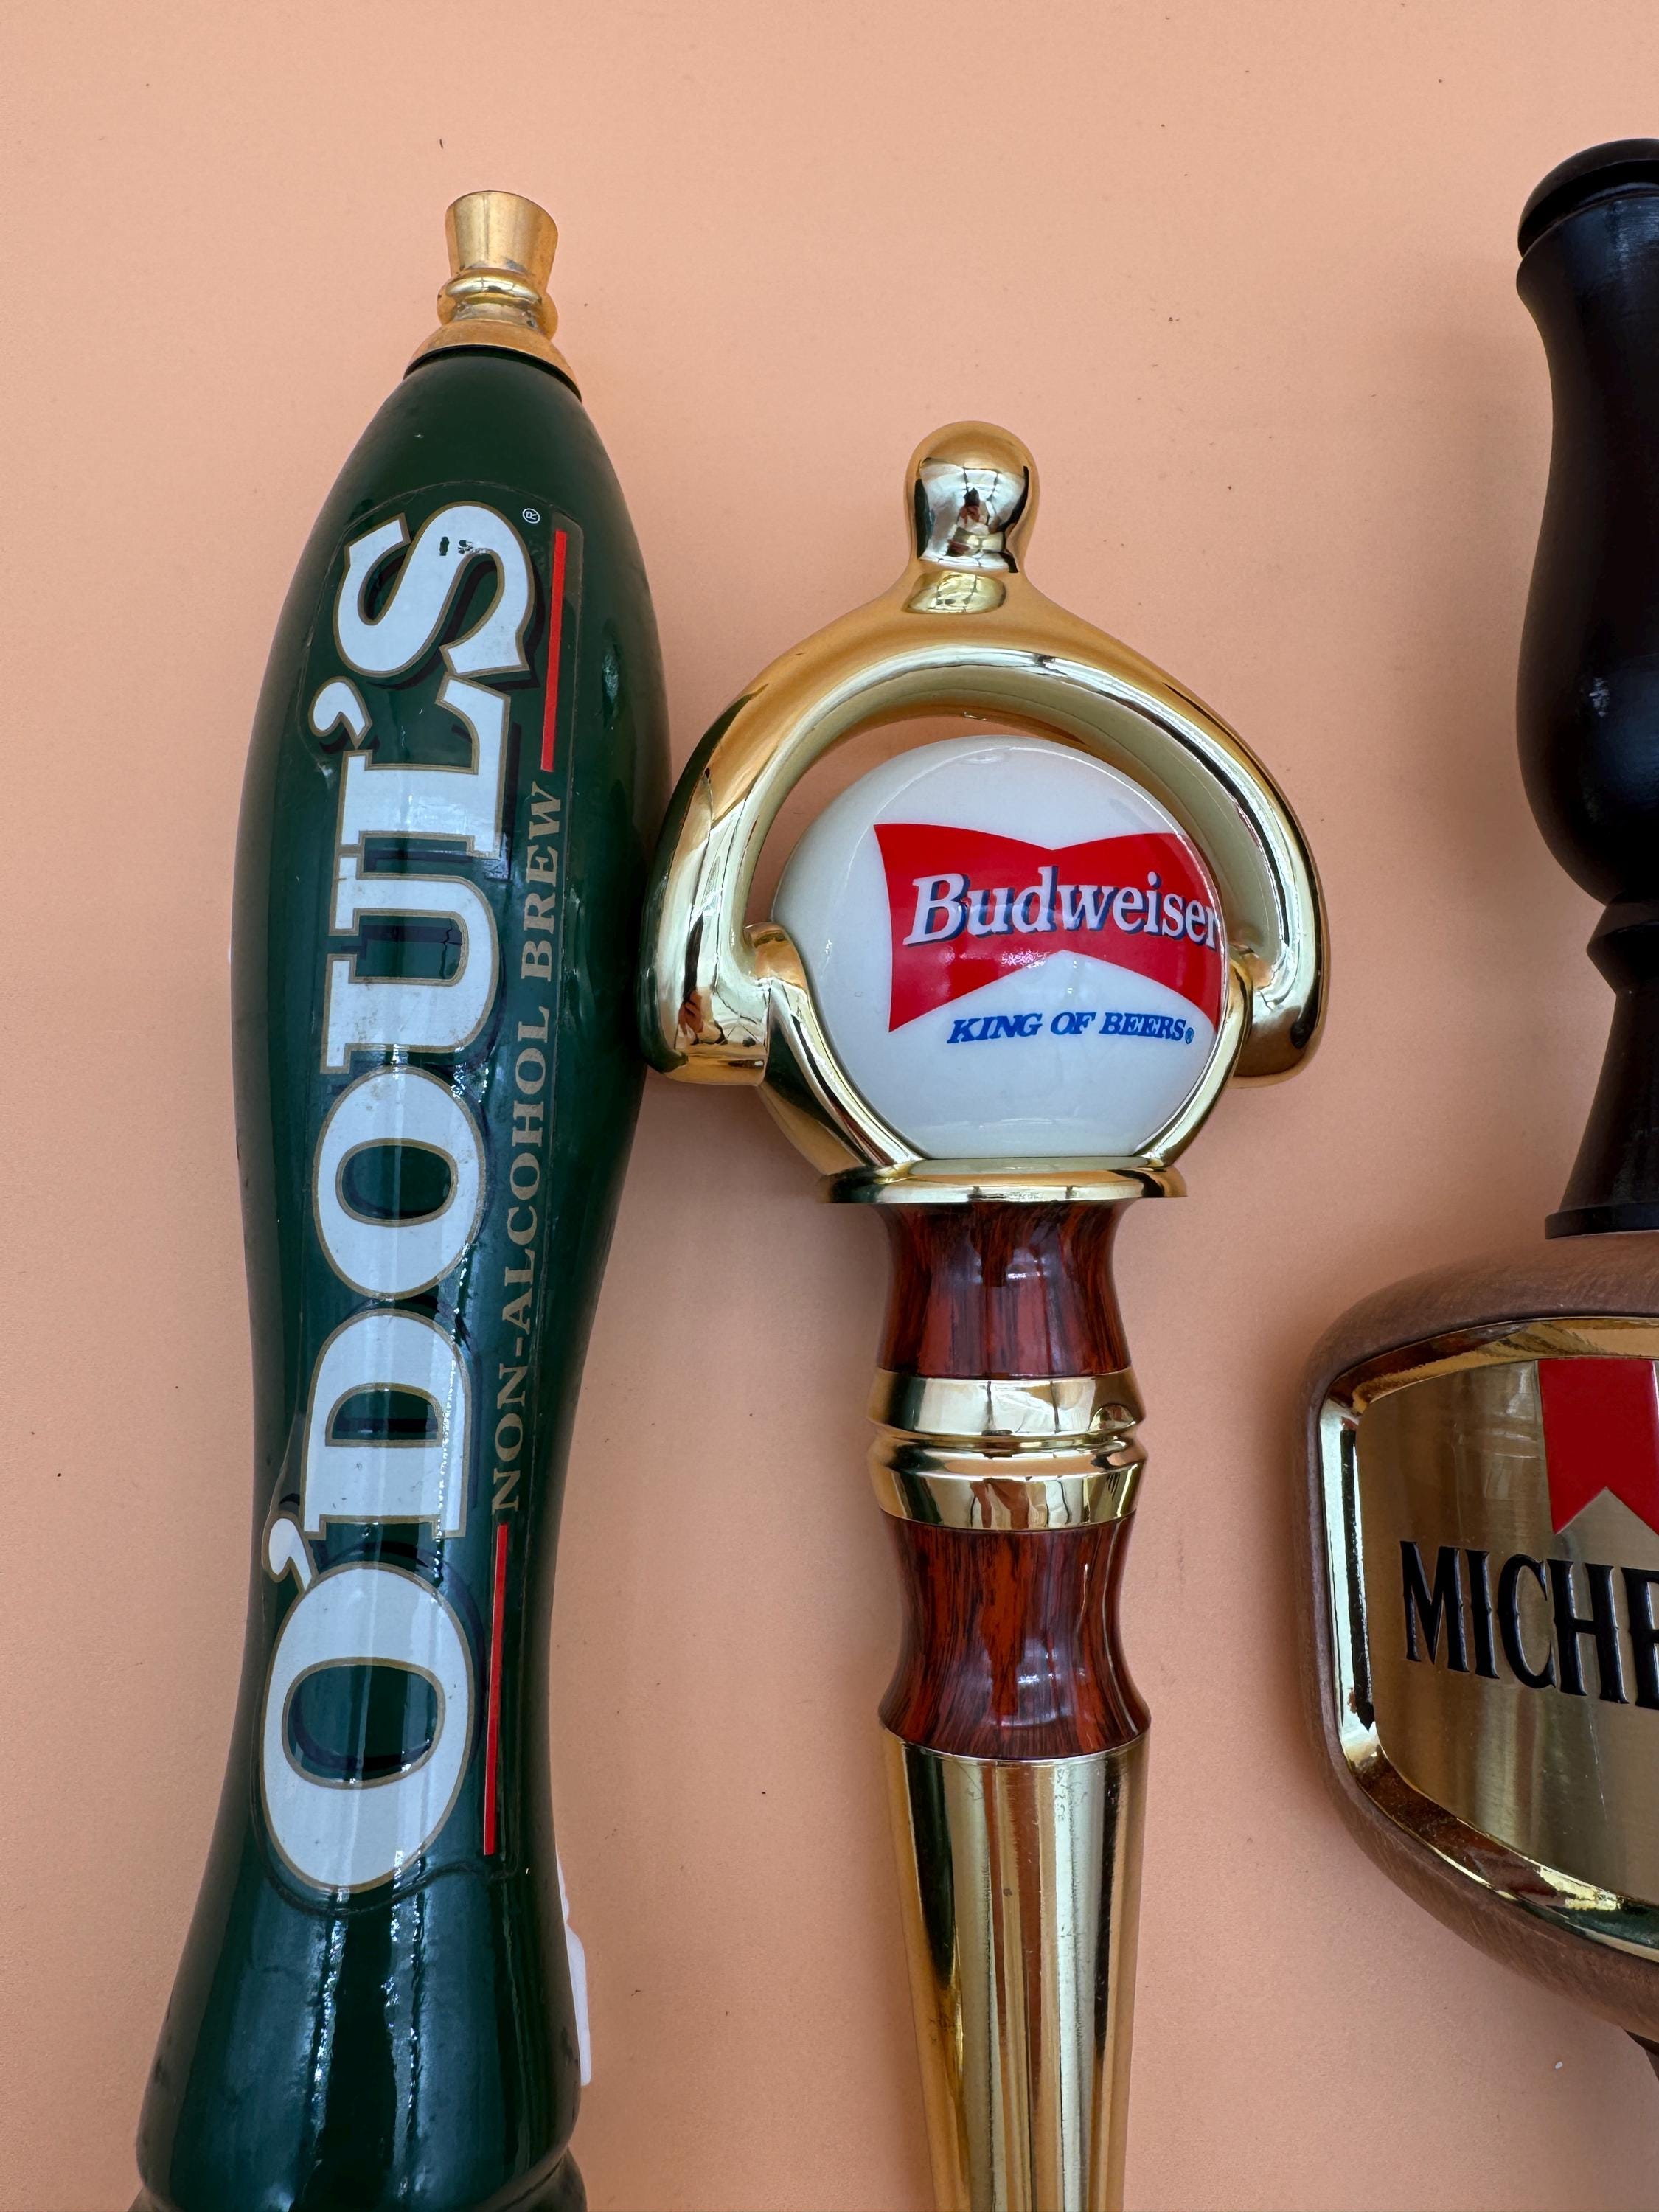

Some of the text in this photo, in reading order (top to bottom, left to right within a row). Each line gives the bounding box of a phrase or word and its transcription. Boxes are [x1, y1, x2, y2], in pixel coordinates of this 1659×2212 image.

[902, 866, 1218, 951] Budweiser
[947, 1012, 1186, 1044] KING OF BEERS
[260, 501, 536, 1893] O'DOUL'S
[491, 781, 562, 1513] NON-ALCOHOL BREW
